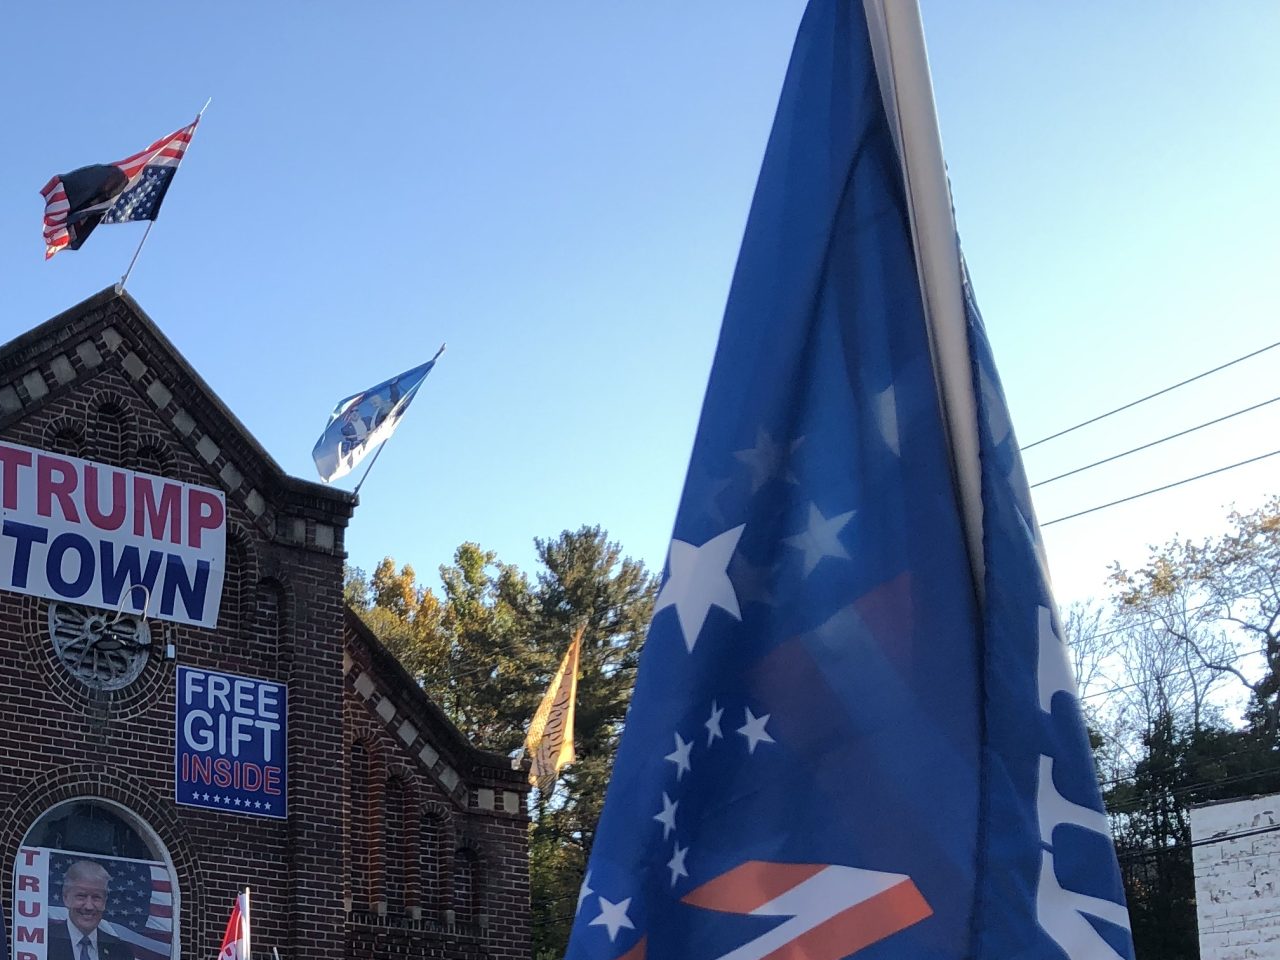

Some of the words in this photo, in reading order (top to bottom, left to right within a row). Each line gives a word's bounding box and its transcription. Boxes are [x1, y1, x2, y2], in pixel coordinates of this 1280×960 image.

[2, 520, 210, 622] TOWN
[185, 671, 279, 719] FREE
[184, 710, 280, 762] GIFT
[182, 754, 281, 795] INSIDE
